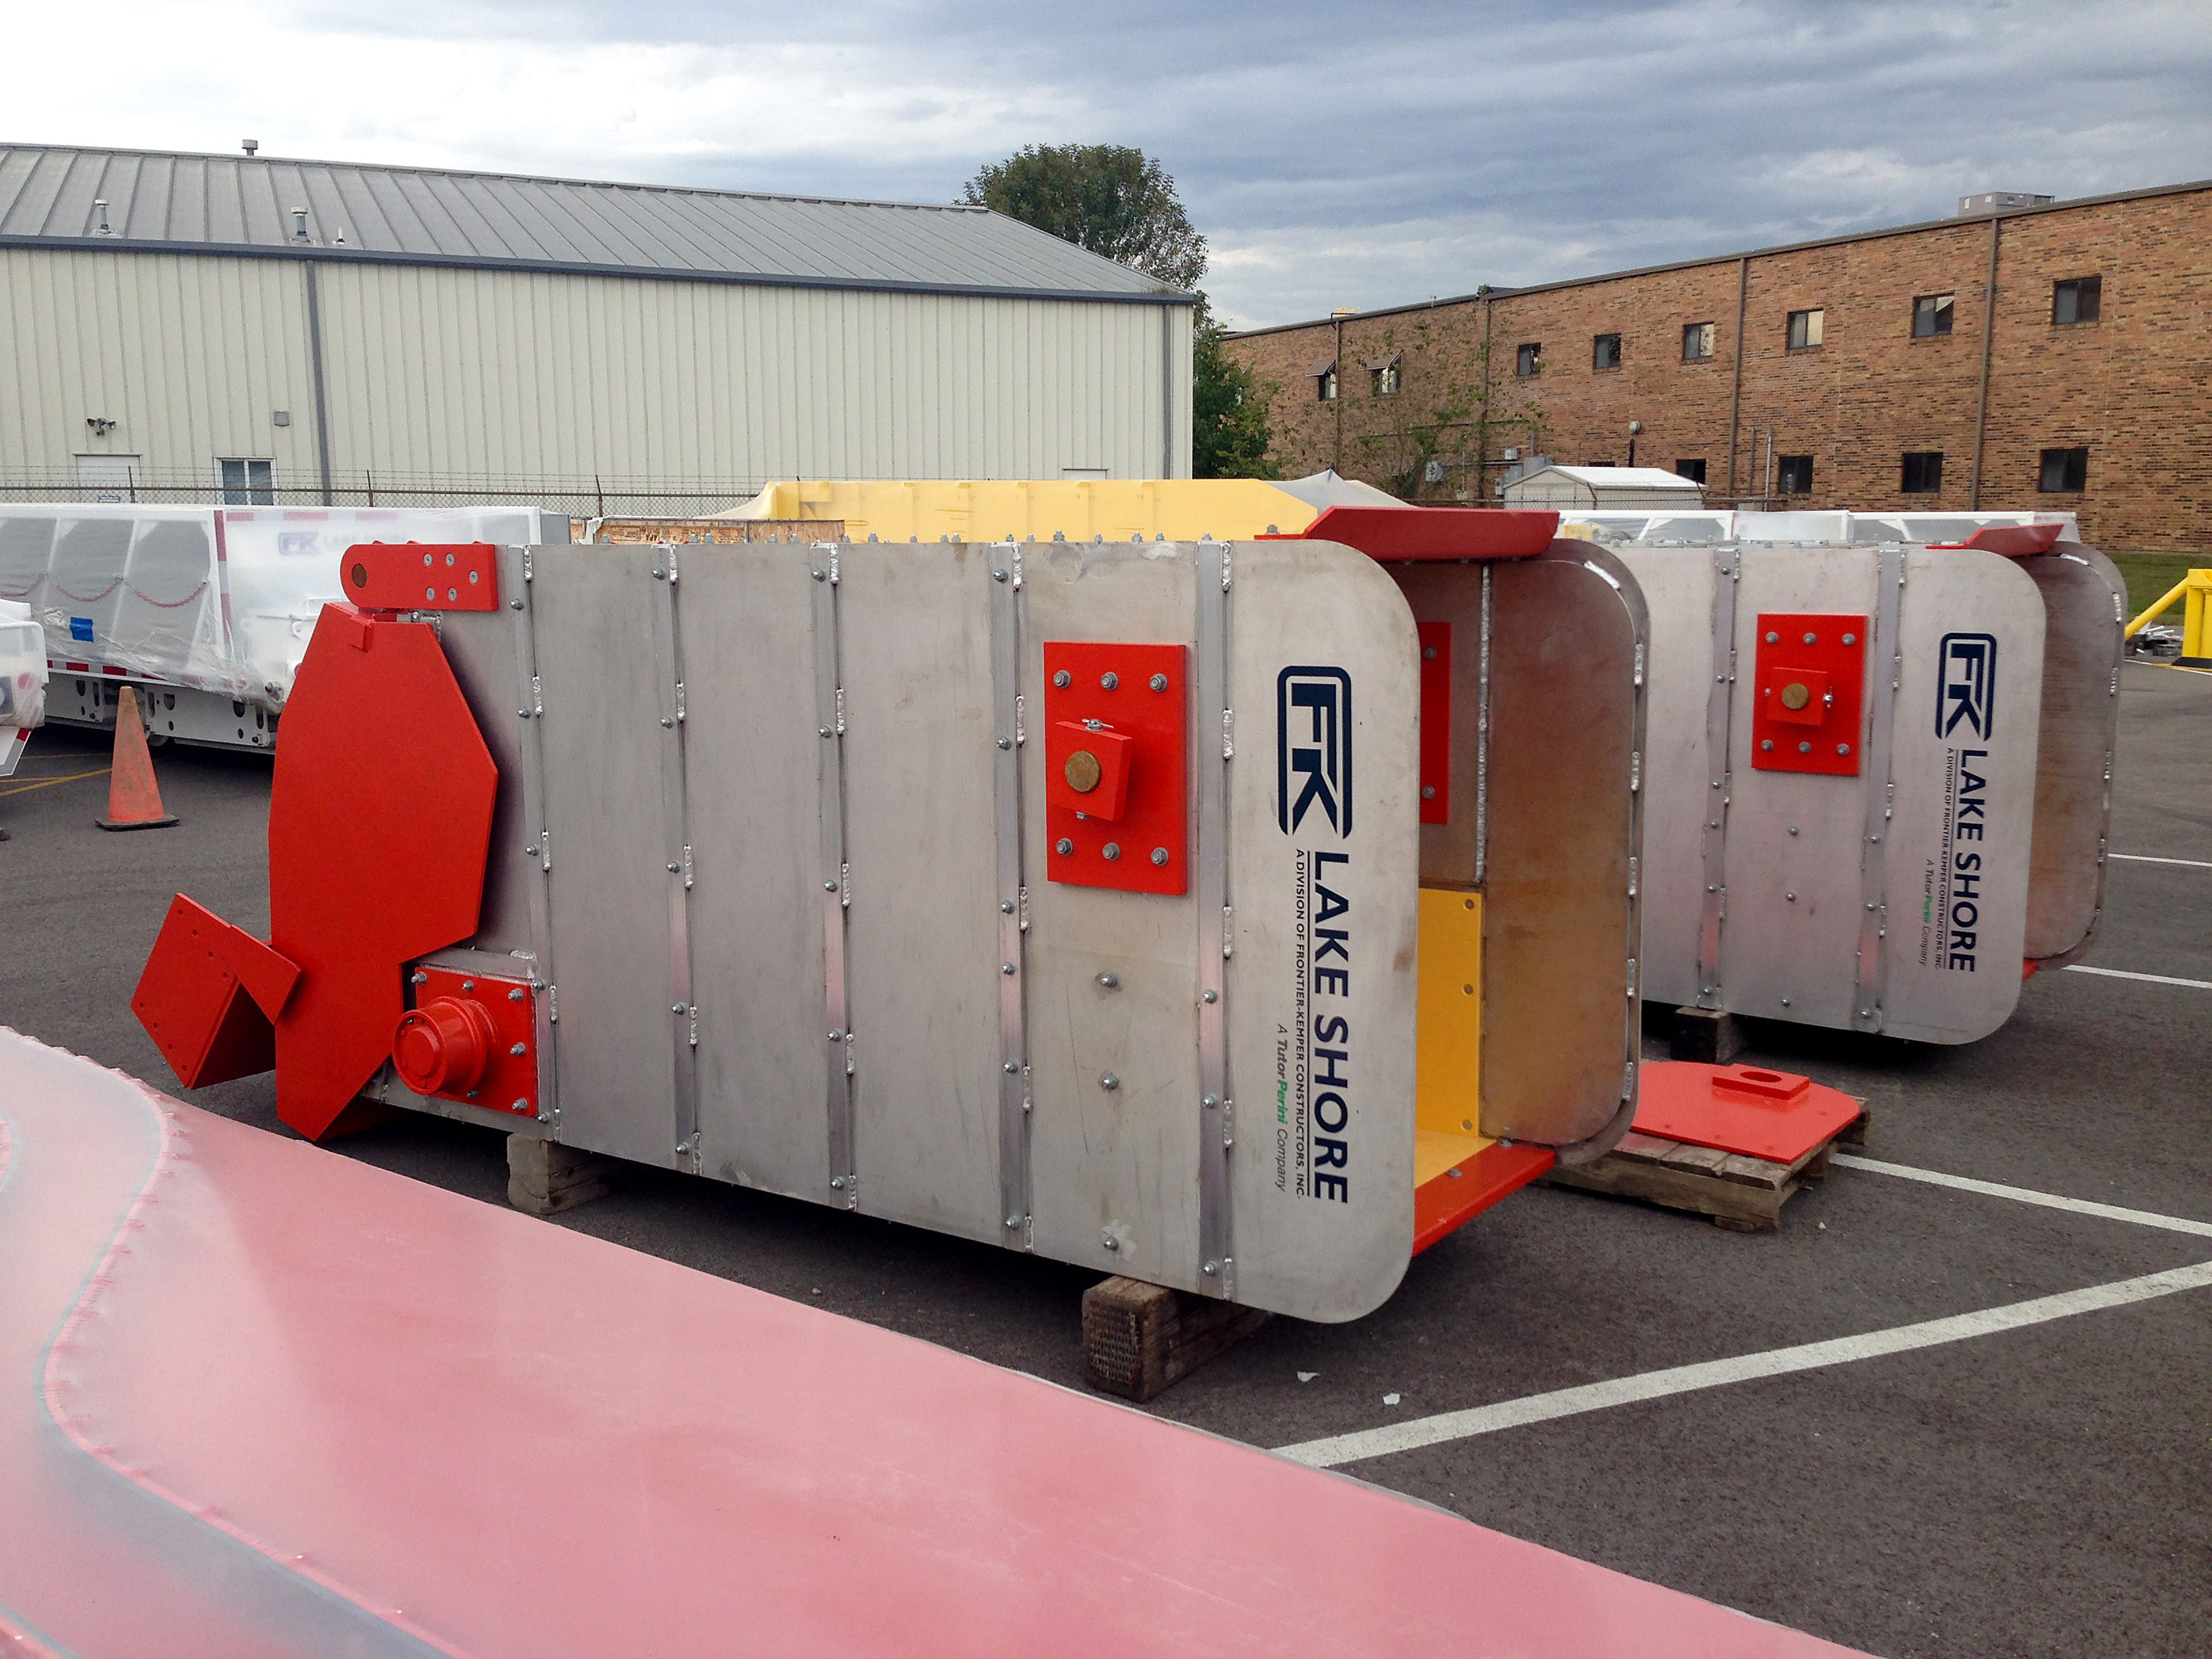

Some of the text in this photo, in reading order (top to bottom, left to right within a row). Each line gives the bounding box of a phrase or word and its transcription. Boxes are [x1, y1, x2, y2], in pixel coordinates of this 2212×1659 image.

[1945, 756, 1954, 793] DIVISION
[1296, 848, 1305, 858] A
[1949, 750, 1987, 972] LAKE SHORE
[1296, 861, 1305, 920] DIVISION
[1296, 923, 1305, 940] OF
[1277, 1023, 1288, 1034] A
[1296, 944, 1305, 1061] FRONTIER-KEMPER
[1314, 851, 1348, 1203] LAKE SHORE
[1295, 1064, 1305, 1170] CONSTRUCTORS,
[1274, 1128, 1288, 1192] Company
